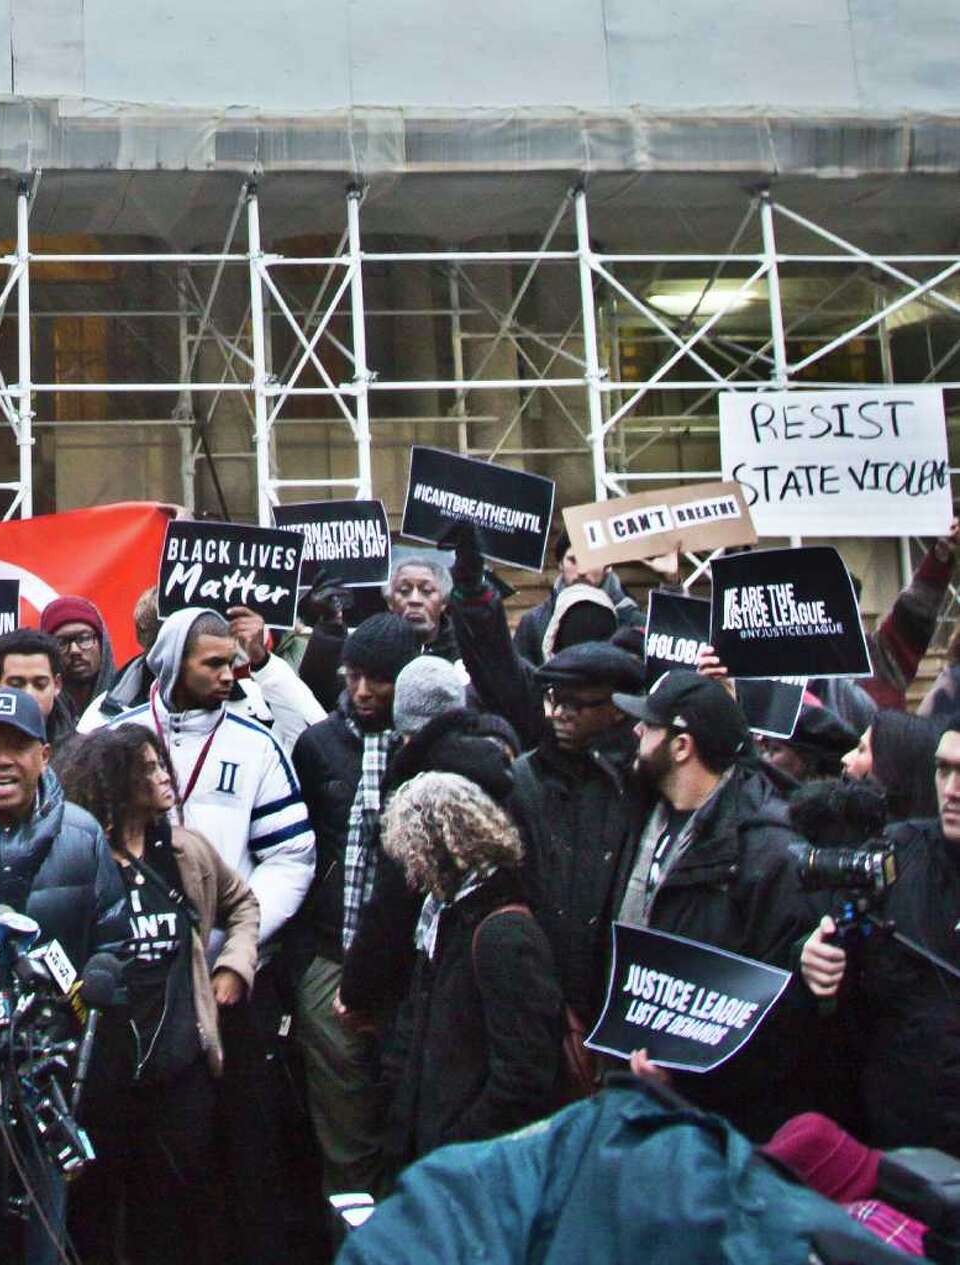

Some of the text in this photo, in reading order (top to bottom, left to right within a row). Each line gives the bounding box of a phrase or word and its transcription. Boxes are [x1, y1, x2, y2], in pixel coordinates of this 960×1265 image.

[750, 401, 914, 443] RESIST
[732, 463, 840, 505] STATE
[413, 483, 542, 533] #ICANTBREATHEUNTIL
[589, 501, 736, 543] I CAN'T BREATHE
[278, 519, 387, 544] RNATIONAL
[315, 540, 360, 561] RIGHTS
[362, 539, 388, 559] DAY
[166, 537, 297, 571] BLACK LIVES
[165, 562, 290, 605] Matter
[740, 585, 766, 610] ARE
[766, 583, 795, 607] THE
[722, 604, 772, 630] JUSTICE
[623, 963, 760, 1029] JUSTICE LEAGUE
[624, 999, 730, 1046] LIST OF DEMANDS
